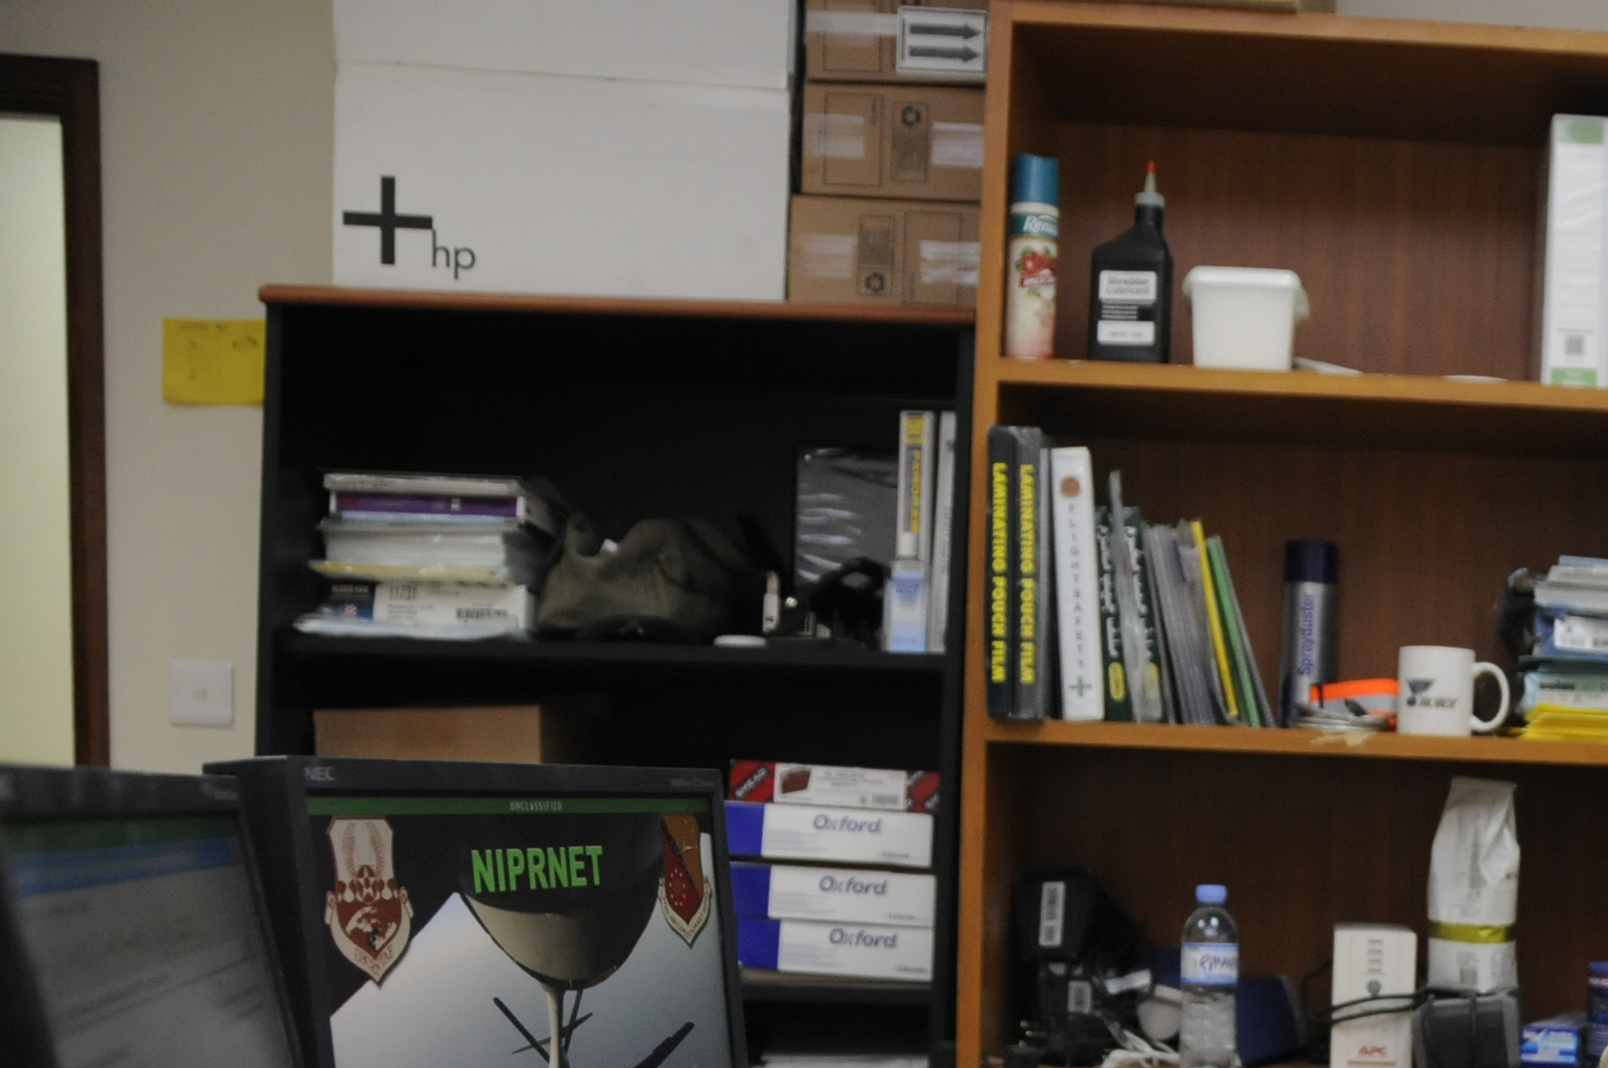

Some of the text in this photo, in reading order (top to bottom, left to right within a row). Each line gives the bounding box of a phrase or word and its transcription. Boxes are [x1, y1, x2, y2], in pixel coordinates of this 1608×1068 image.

[431, 228, 477, 279] hp
[991, 462, 1007, 683] LAMINATING POUCH FILM
[1020, 464, 1035, 684] LAMINATING POUCH FILM
[305, 767, 335, 781] NEC
[510, 801, 562, 811] UNCLASSIFIED
[813, 813, 882, 833] Oxford
[471, 845, 602, 893] NIPRNET
[819, 875, 888, 895] Oxford
[829, 927, 898, 948] Oxford
